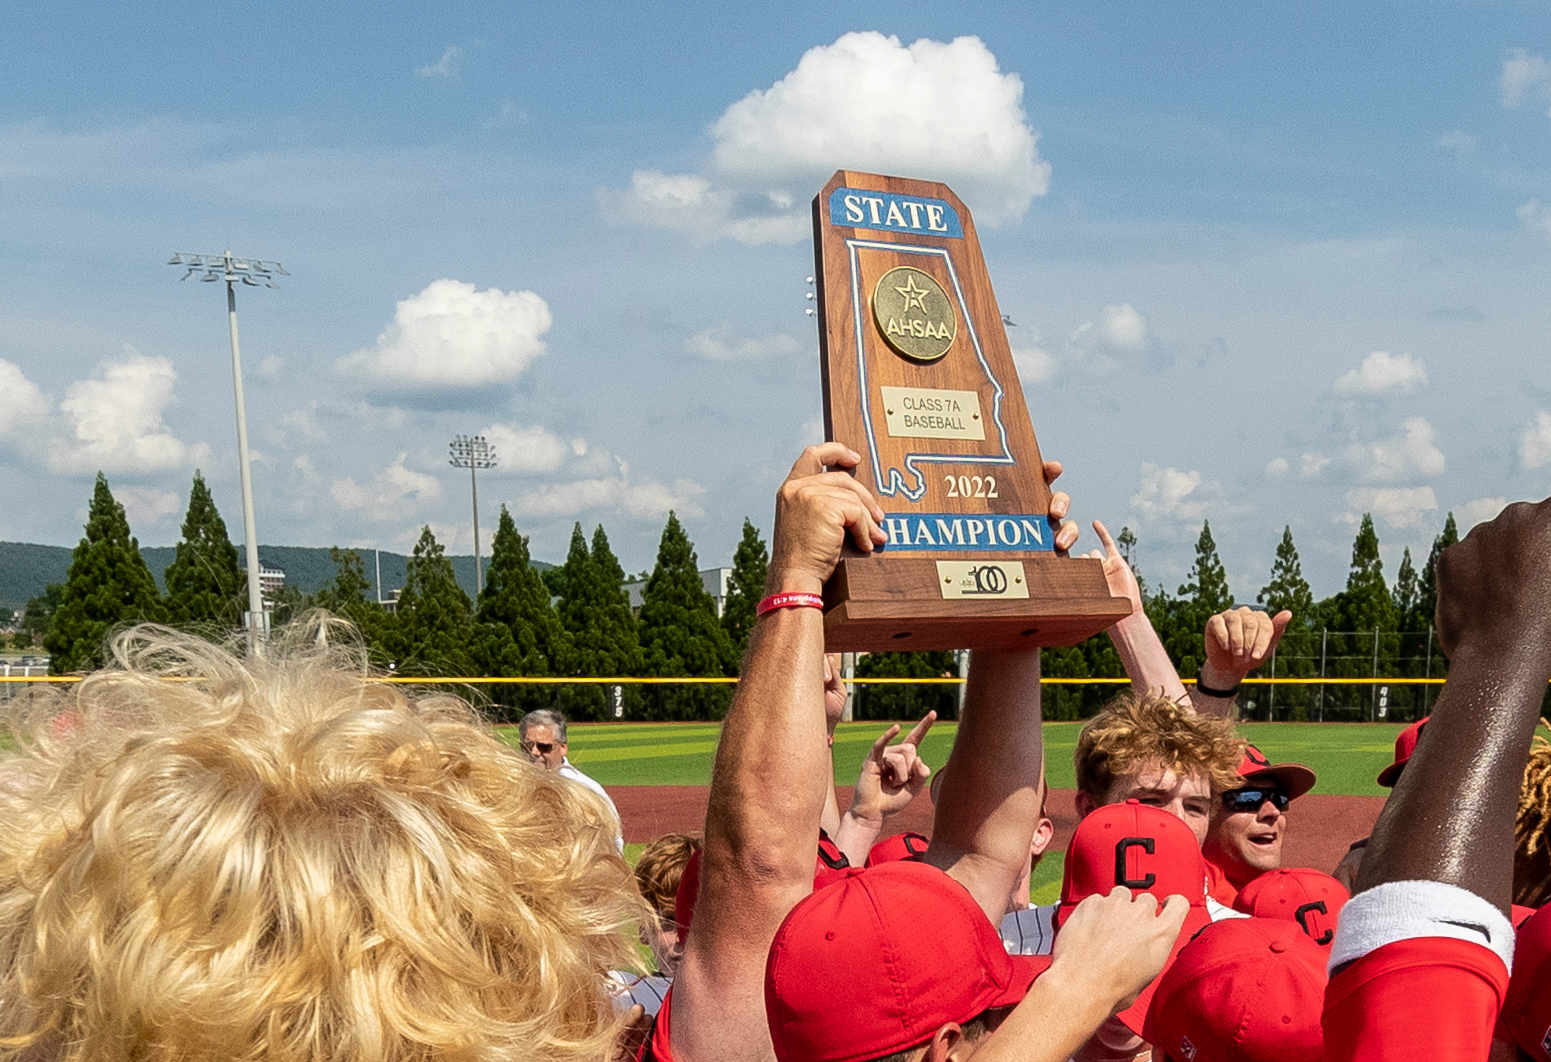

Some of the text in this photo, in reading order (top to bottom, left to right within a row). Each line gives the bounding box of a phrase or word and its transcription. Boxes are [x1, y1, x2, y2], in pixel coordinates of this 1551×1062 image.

[844, 194, 948, 231] STATE
[887, 317, 953, 341] AHSAA
[903, 396, 961, 412] CLASS 7A
[904, 415, 966, 430] BASEBALL
[944, 475, 999, 498] 2022
[881, 518, 1044, 546] HAMPION
[1115, 837, 1156, 889] C
[1295, 900, 1333, 946] C
